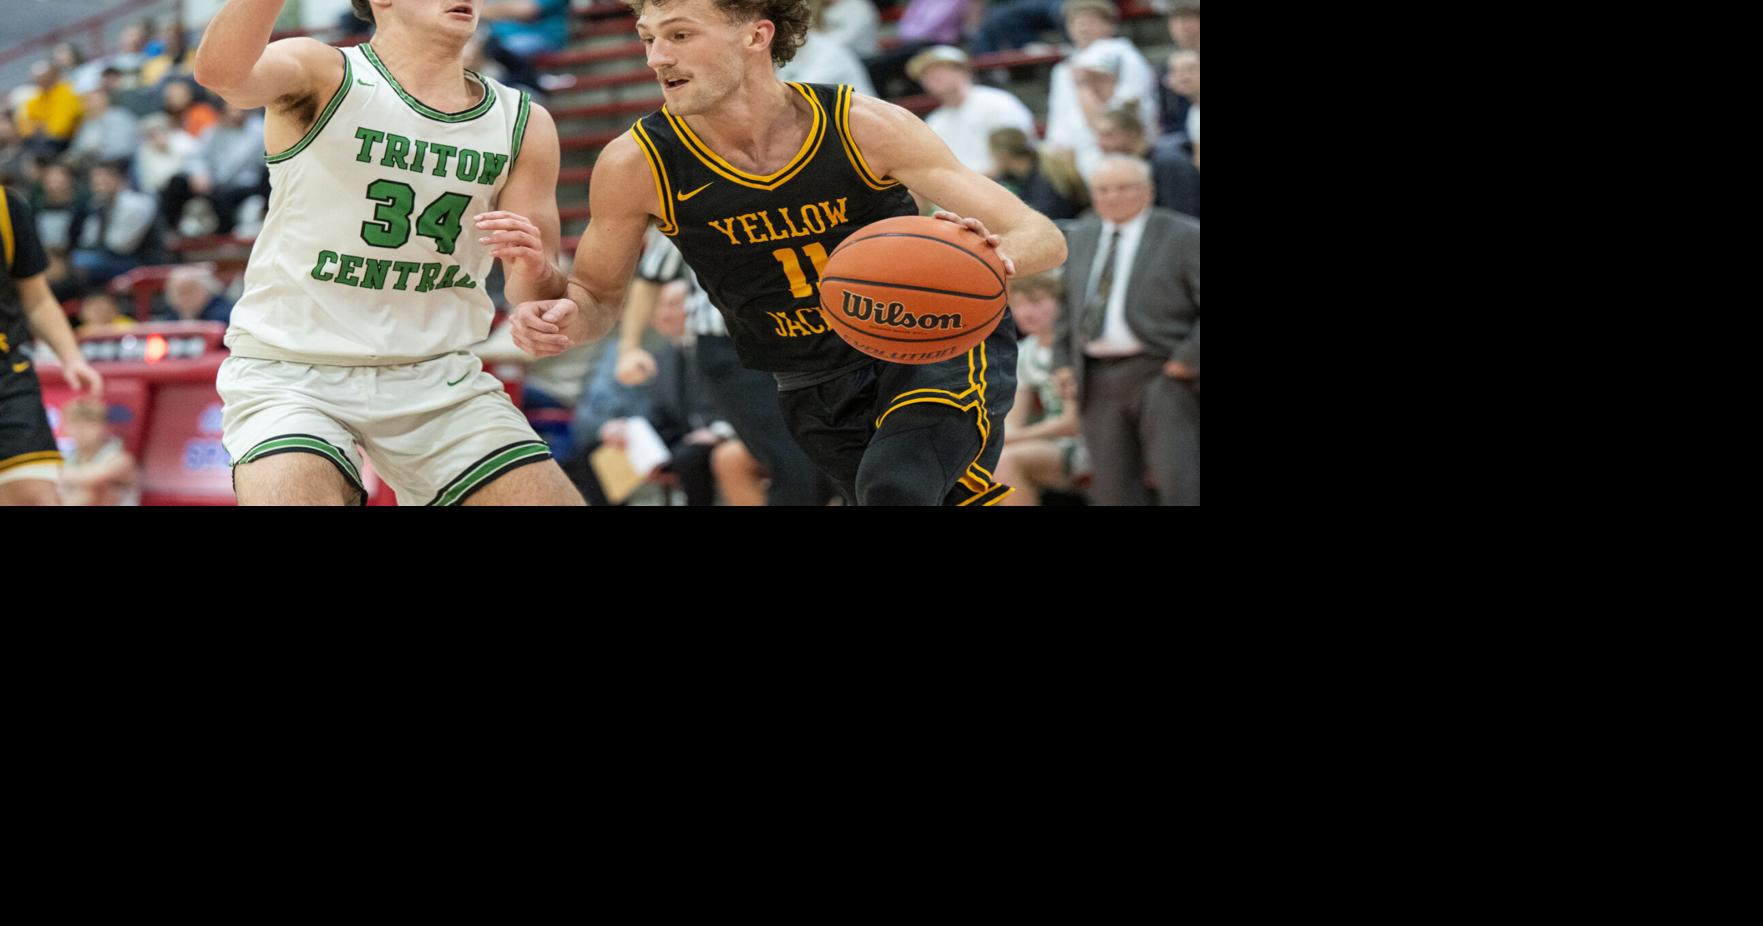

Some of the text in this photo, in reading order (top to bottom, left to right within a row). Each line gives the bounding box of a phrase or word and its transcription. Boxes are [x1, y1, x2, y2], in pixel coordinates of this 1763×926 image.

[355, 127, 509, 185] TRITON
[361, 178, 473, 255] 34
[709, 197, 849, 244] YELLOW
[841, 289, 962, 330] Wilson
